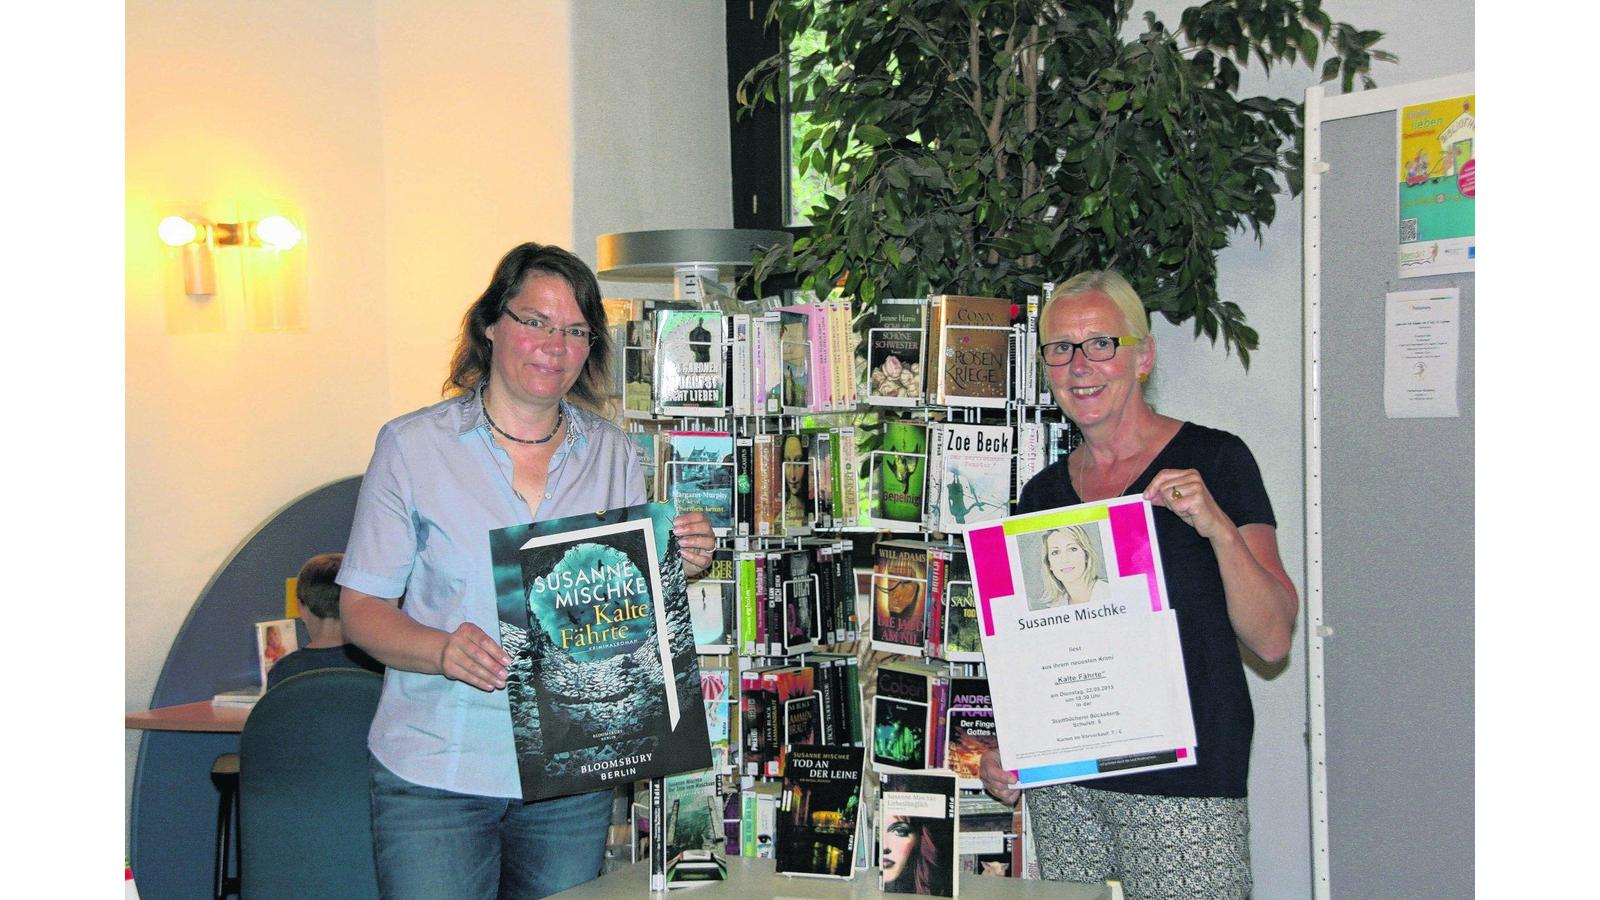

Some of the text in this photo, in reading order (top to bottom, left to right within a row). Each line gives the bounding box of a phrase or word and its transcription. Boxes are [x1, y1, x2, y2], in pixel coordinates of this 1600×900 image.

[874, 340, 919, 350] SCHWESTER
[954, 349, 1003, 368] ROSEN
[945, 364, 997, 391] KRIEGE
[689, 389, 720, 403] LIEBEN
[977, 430, 1009, 453] Beck
[702, 490, 728, 501] Murphy
[883, 491, 922, 507] Gepeinig
[879, 549, 926, 562] WILL ADAMS
[712, 560, 733, 570] DER
[534, 560, 634, 593] SUSANNE
[556, 577, 648, 609] MISCHKE
[593, 598, 650, 626] Kalte
[1018, 602, 1127, 631] Susanne Mischke
[561, 623, 629, 650] Fährte
[953, 694, 992, 705] ANDRE
[951, 704, 993, 718] FRAN
[960, 720, 996, 729] Der Finge
[966, 728, 991, 736] Gottes
[580, 752, 653, 775] BLOOMSBURY
[792, 759, 830, 769] TOD AN
[600, 767, 636, 781] BERLIN
[809, 769, 858, 780] DER LEINE
